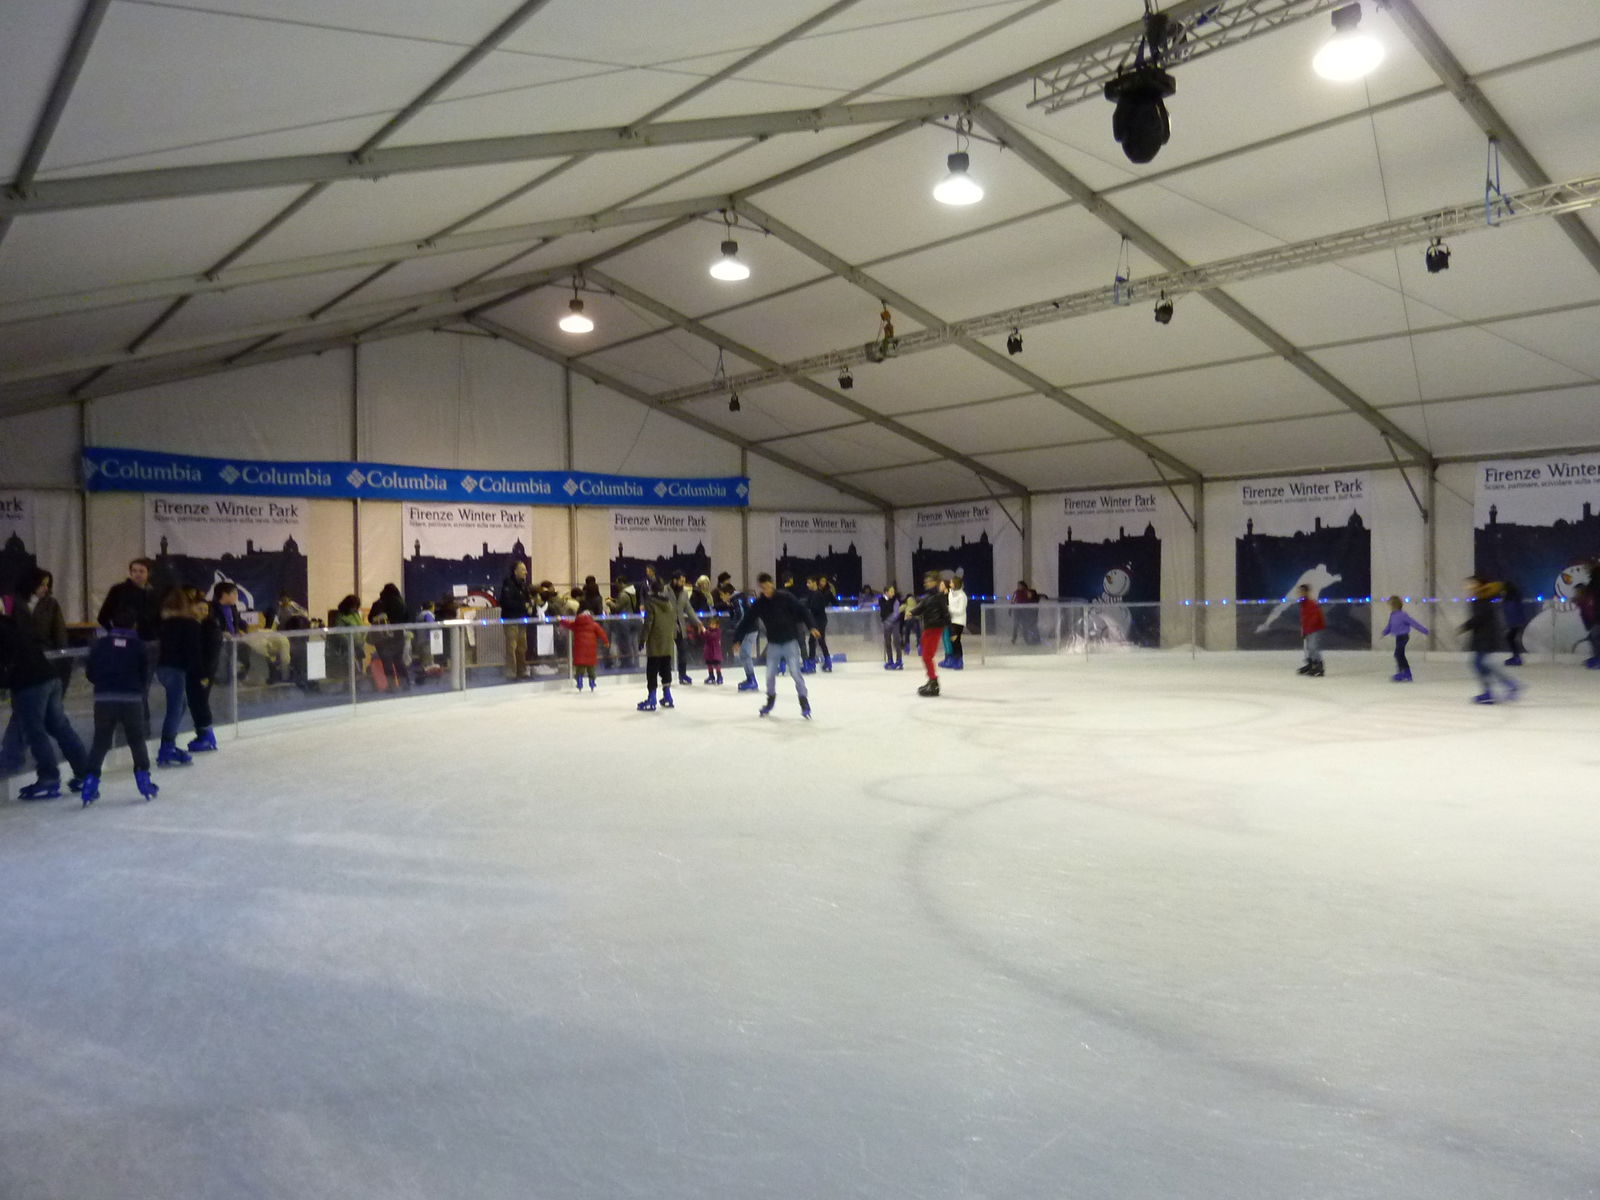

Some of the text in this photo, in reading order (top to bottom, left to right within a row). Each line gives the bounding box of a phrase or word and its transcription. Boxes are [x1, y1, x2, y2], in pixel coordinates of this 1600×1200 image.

[101, 459, 202, 482] Columbia
[242, 468, 332, 486] Columbia
[1485, 468, 1541, 482] Firenze
[367, 470, 448, 490] Columbia
[479, 476, 551, 494] Columbia
[579, 480, 644, 496] Columbia
[1243, 477, 1363, 499] Firenze Winter Park
[668, 481, 727, 497] Columbia
[154, 499, 299, 518] Firenze Winter Park
[1064, 493, 1156, 509] Firenze Winter Park
[410, 507, 525, 523] Firenze Winter Park
[615, 512, 706, 527] Firenze Winter Park
[812, 517, 838, 529] Winter
[840, 518, 857, 529] Park
